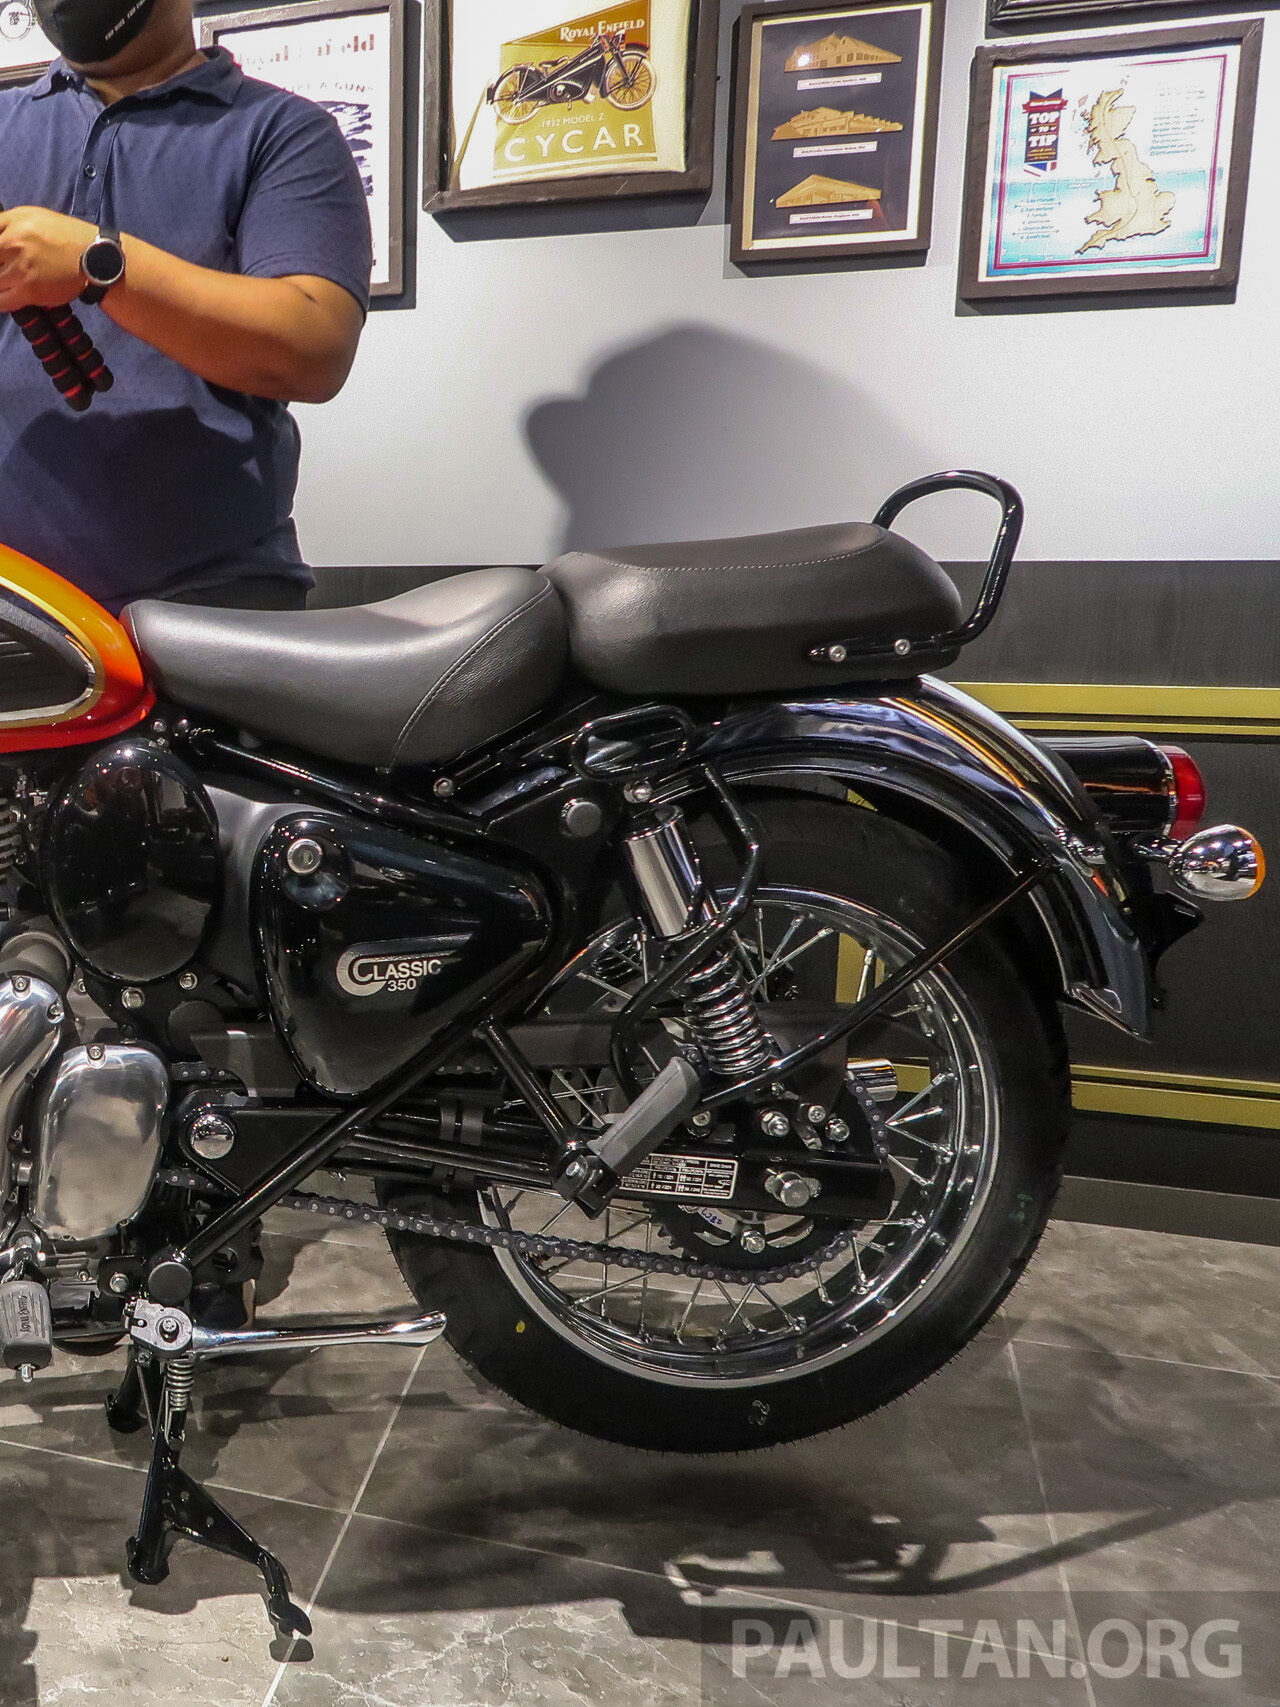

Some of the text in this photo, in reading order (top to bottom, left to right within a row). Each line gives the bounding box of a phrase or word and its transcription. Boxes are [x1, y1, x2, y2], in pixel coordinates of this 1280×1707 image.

[560, 18, 645, 42] ROYAL ENFIELD
[562, 114, 596, 126] MODEL
[1029, 111, 1060, 125] TOP
[504, 123, 644, 162] CYCAR
[1028, 134, 1058, 148] TIP
[340, 954, 442, 984] CLASSIC
[387, 978, 417, 992] 350
